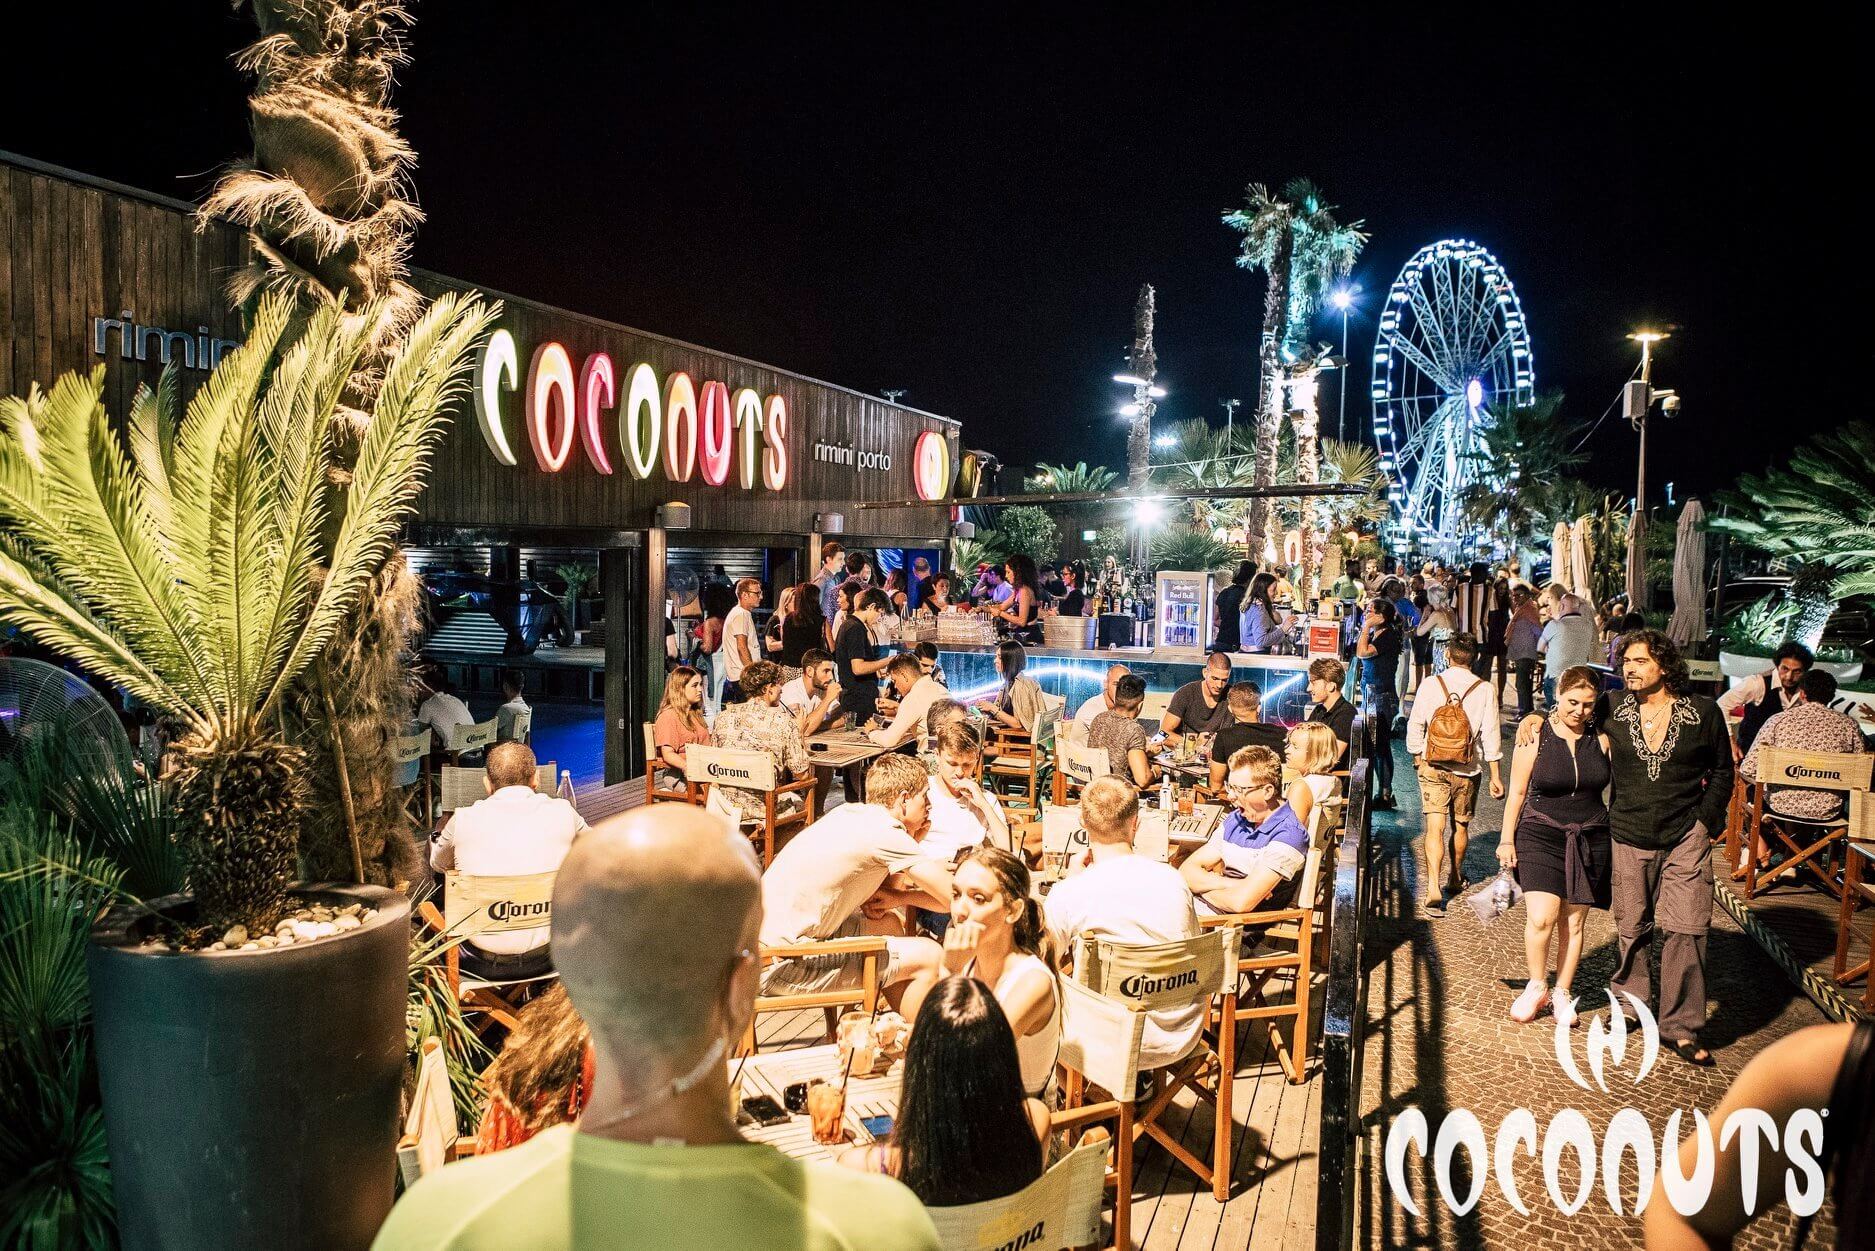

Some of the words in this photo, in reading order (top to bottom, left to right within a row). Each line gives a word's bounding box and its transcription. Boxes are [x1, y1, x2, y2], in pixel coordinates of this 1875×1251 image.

[473, 328, 787, 491] COCONUTS
[814, 438, 853, 466] rimini
[857, 450, 891, 472] porto
[1169, 591, 1181, 599] Red
[1182, 591, 1194, 599] Bull
[707, 762, 750, 779] Corona
[1784, 764, 1842, 781] Corona
[1119, 969, 1198, 1001] Corona
